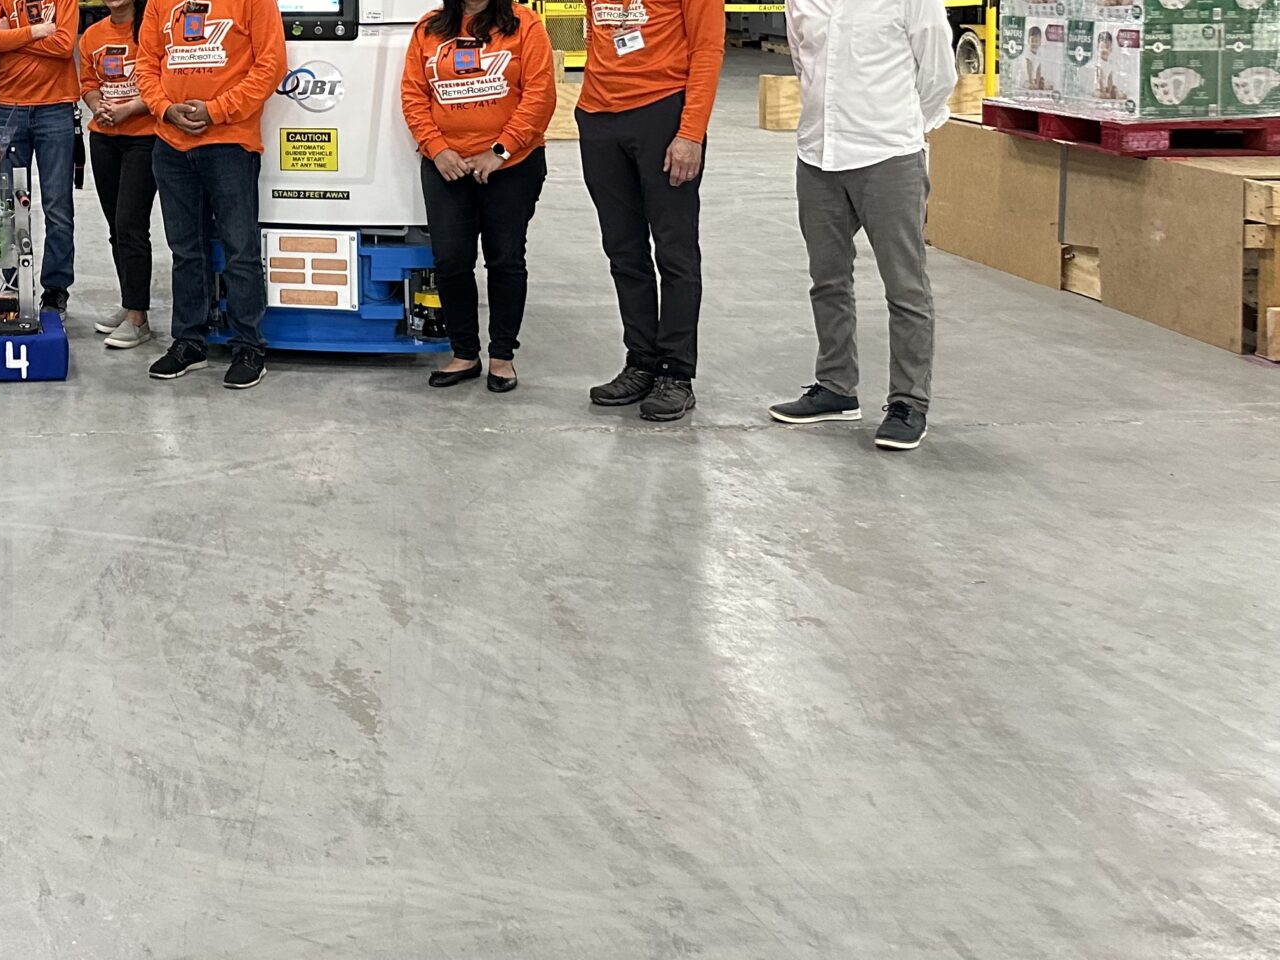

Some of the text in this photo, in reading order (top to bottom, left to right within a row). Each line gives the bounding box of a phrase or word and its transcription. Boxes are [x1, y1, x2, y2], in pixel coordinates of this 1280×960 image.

[297, 80, 342, 95] JBT
[451, 99, 496, 111] FRC 7414
